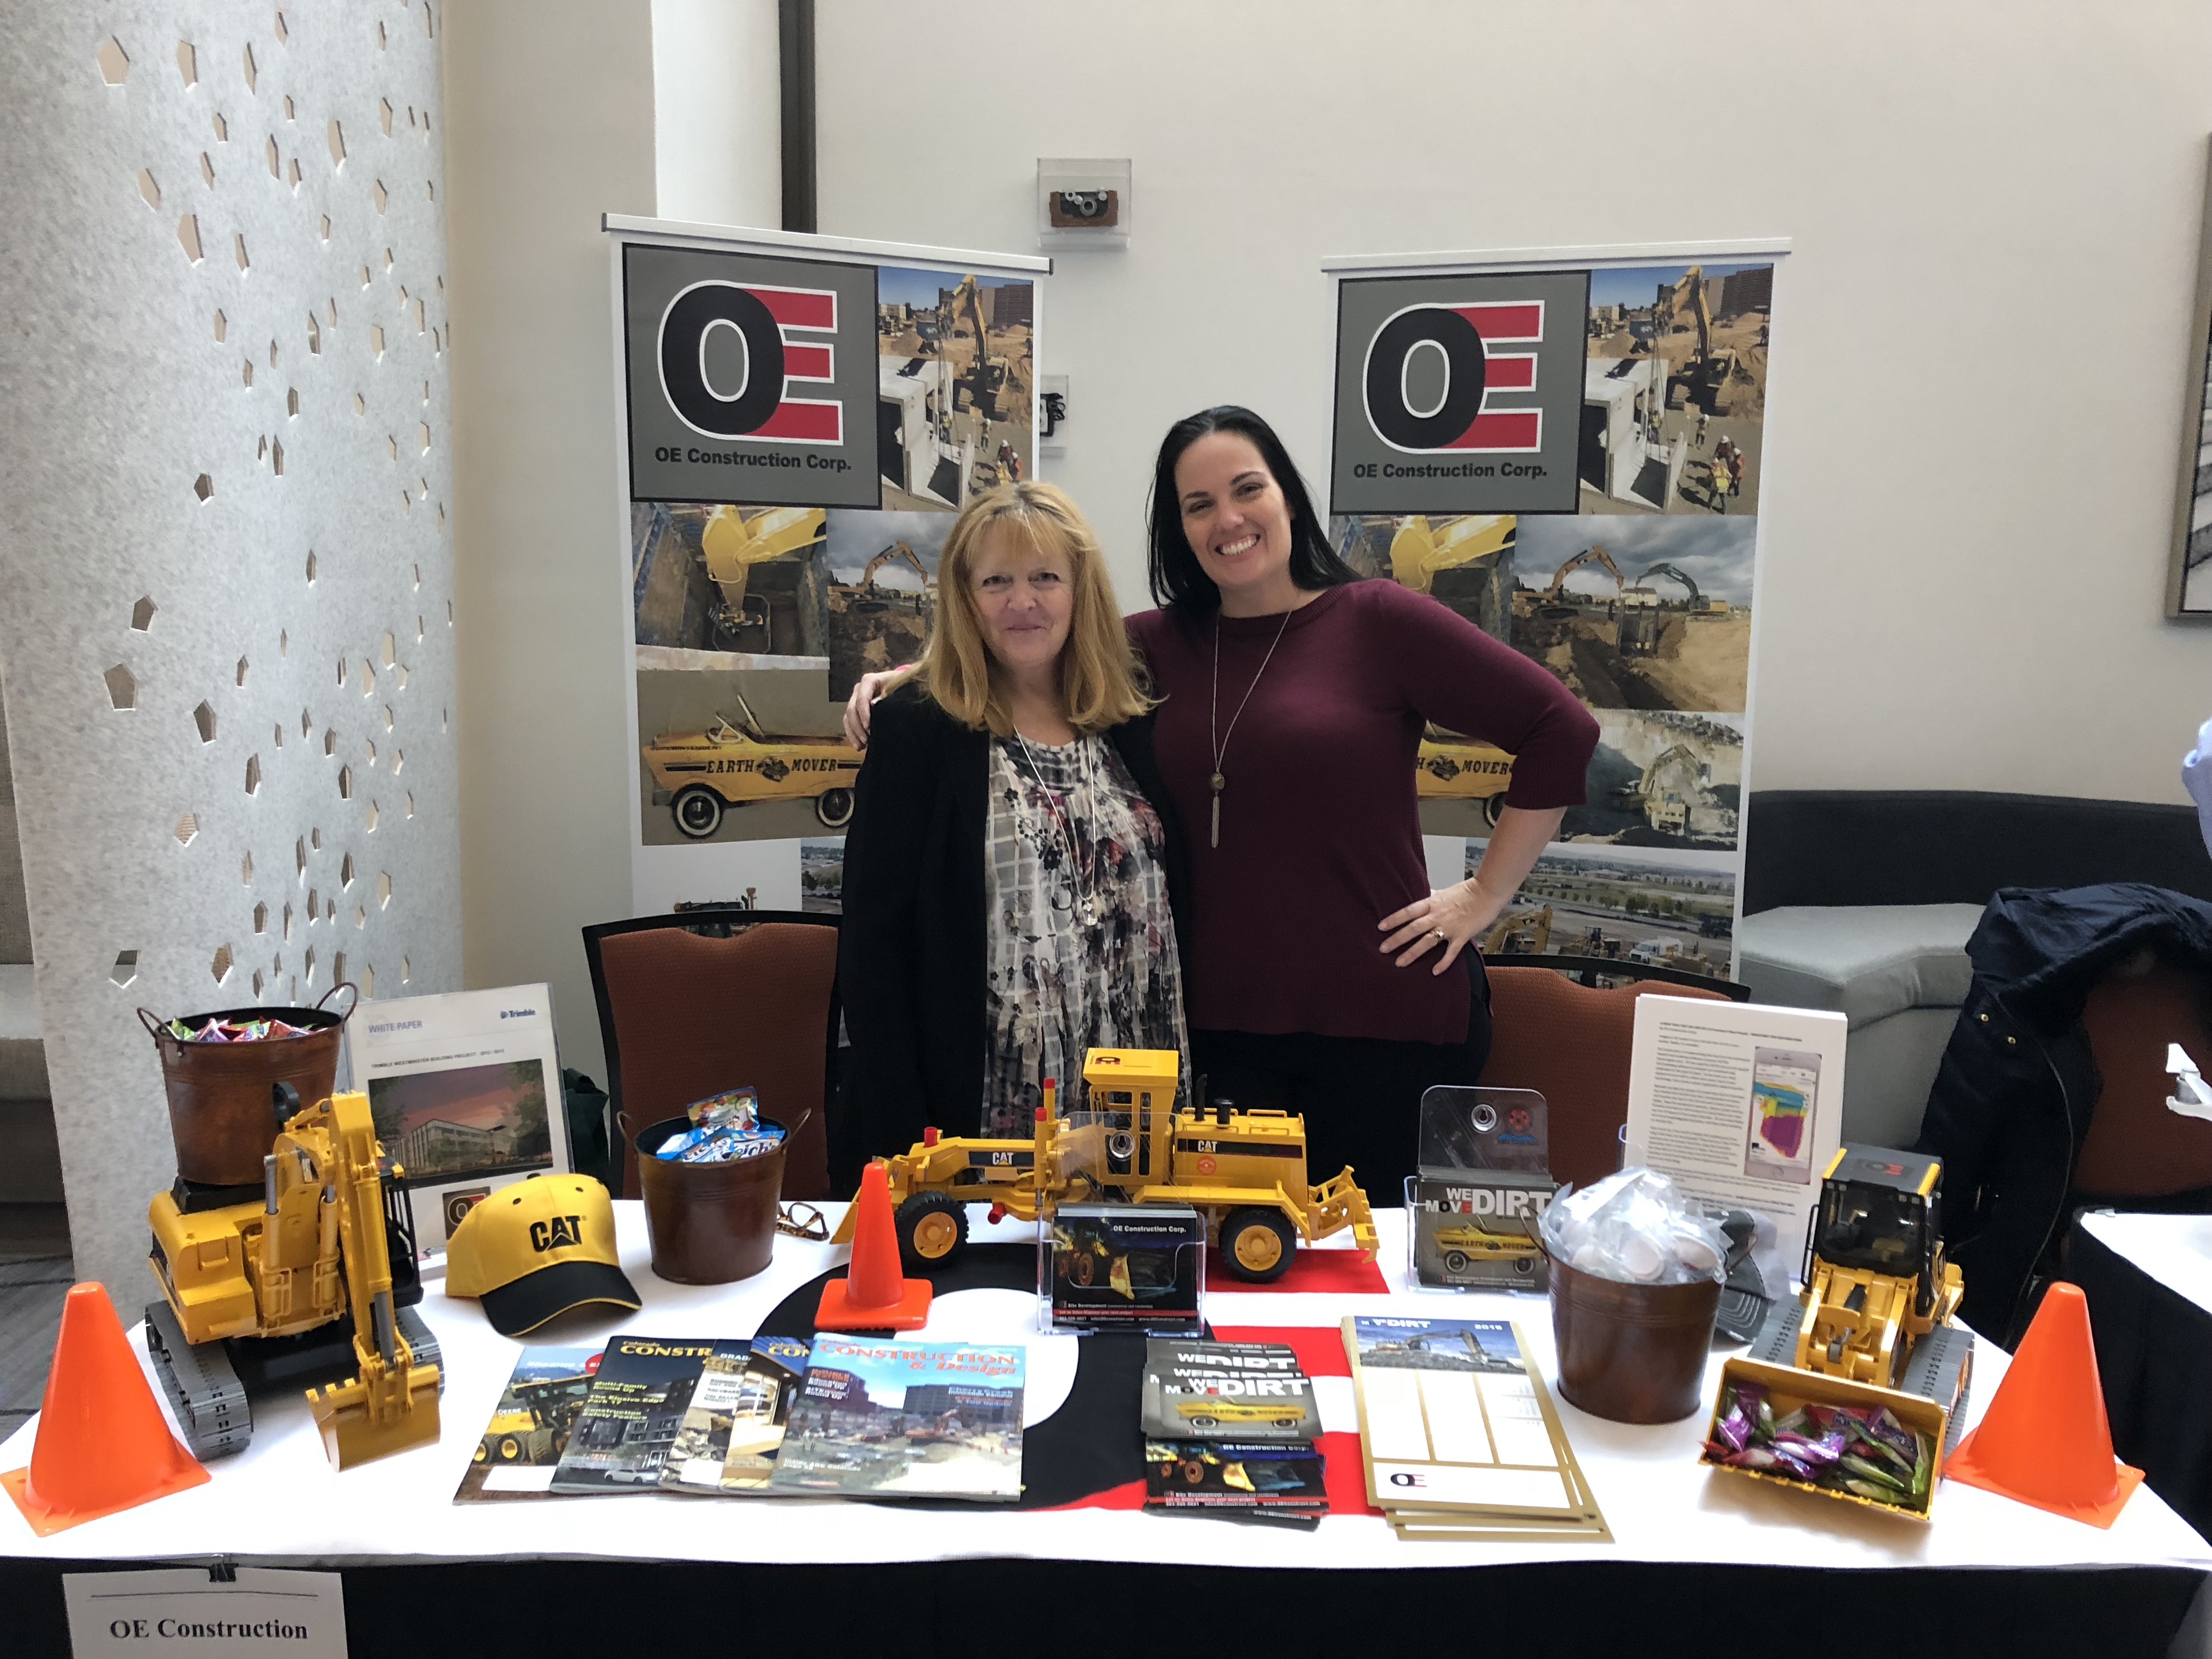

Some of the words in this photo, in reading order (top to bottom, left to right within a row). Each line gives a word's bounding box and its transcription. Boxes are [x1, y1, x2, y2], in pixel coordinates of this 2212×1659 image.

[657, 280, 844, 447] OE
[1363, 300, 1545, 454] OE
[656, 448, 681, 463] OE
[688, 449, 802, 468] Construction
[806, 454, 852, 472] Corp.
[1353, 464, 1378, 478] OE
[1383, 462, 1494, 478] Construction
[1500, 462, 1547, 480] Corp.
[706, 759, 755, 774] EARTH
[791, 759, 838, 772] MOVER
[1462, 759, 1511, 775] MOVER
[509, 1008, 536, 1018] Trimble
[368, 1023, 395, 1033] WHITE
[397, 1020, 422, 1030] PAPER
[1198, 1140, 1218, 1154] CAT
[992, 1152, 1013, 1165] CAT
[1446, 1187, 1472, 1201] WE
[1425, 1200, 1473, 1214] MOVE
[1472, 1188, 1553, 1217] DIRT
[529, 1215, 582, 1252] CAT
[820, 1343, 1014, 1365] CONSTRUCTION
[909, 1361, 926, 1370] &
[935, 1362, 1017, 1376] Design
[595, 1381, 648, 1390] Multi-Family
[1188, 1378, 1218, 1388] WE
[1218, 1379, 1310, 1396] DIRT
[110, 1620, 149, 1639] OE
[157, 1618, 308, 1639] Construction
